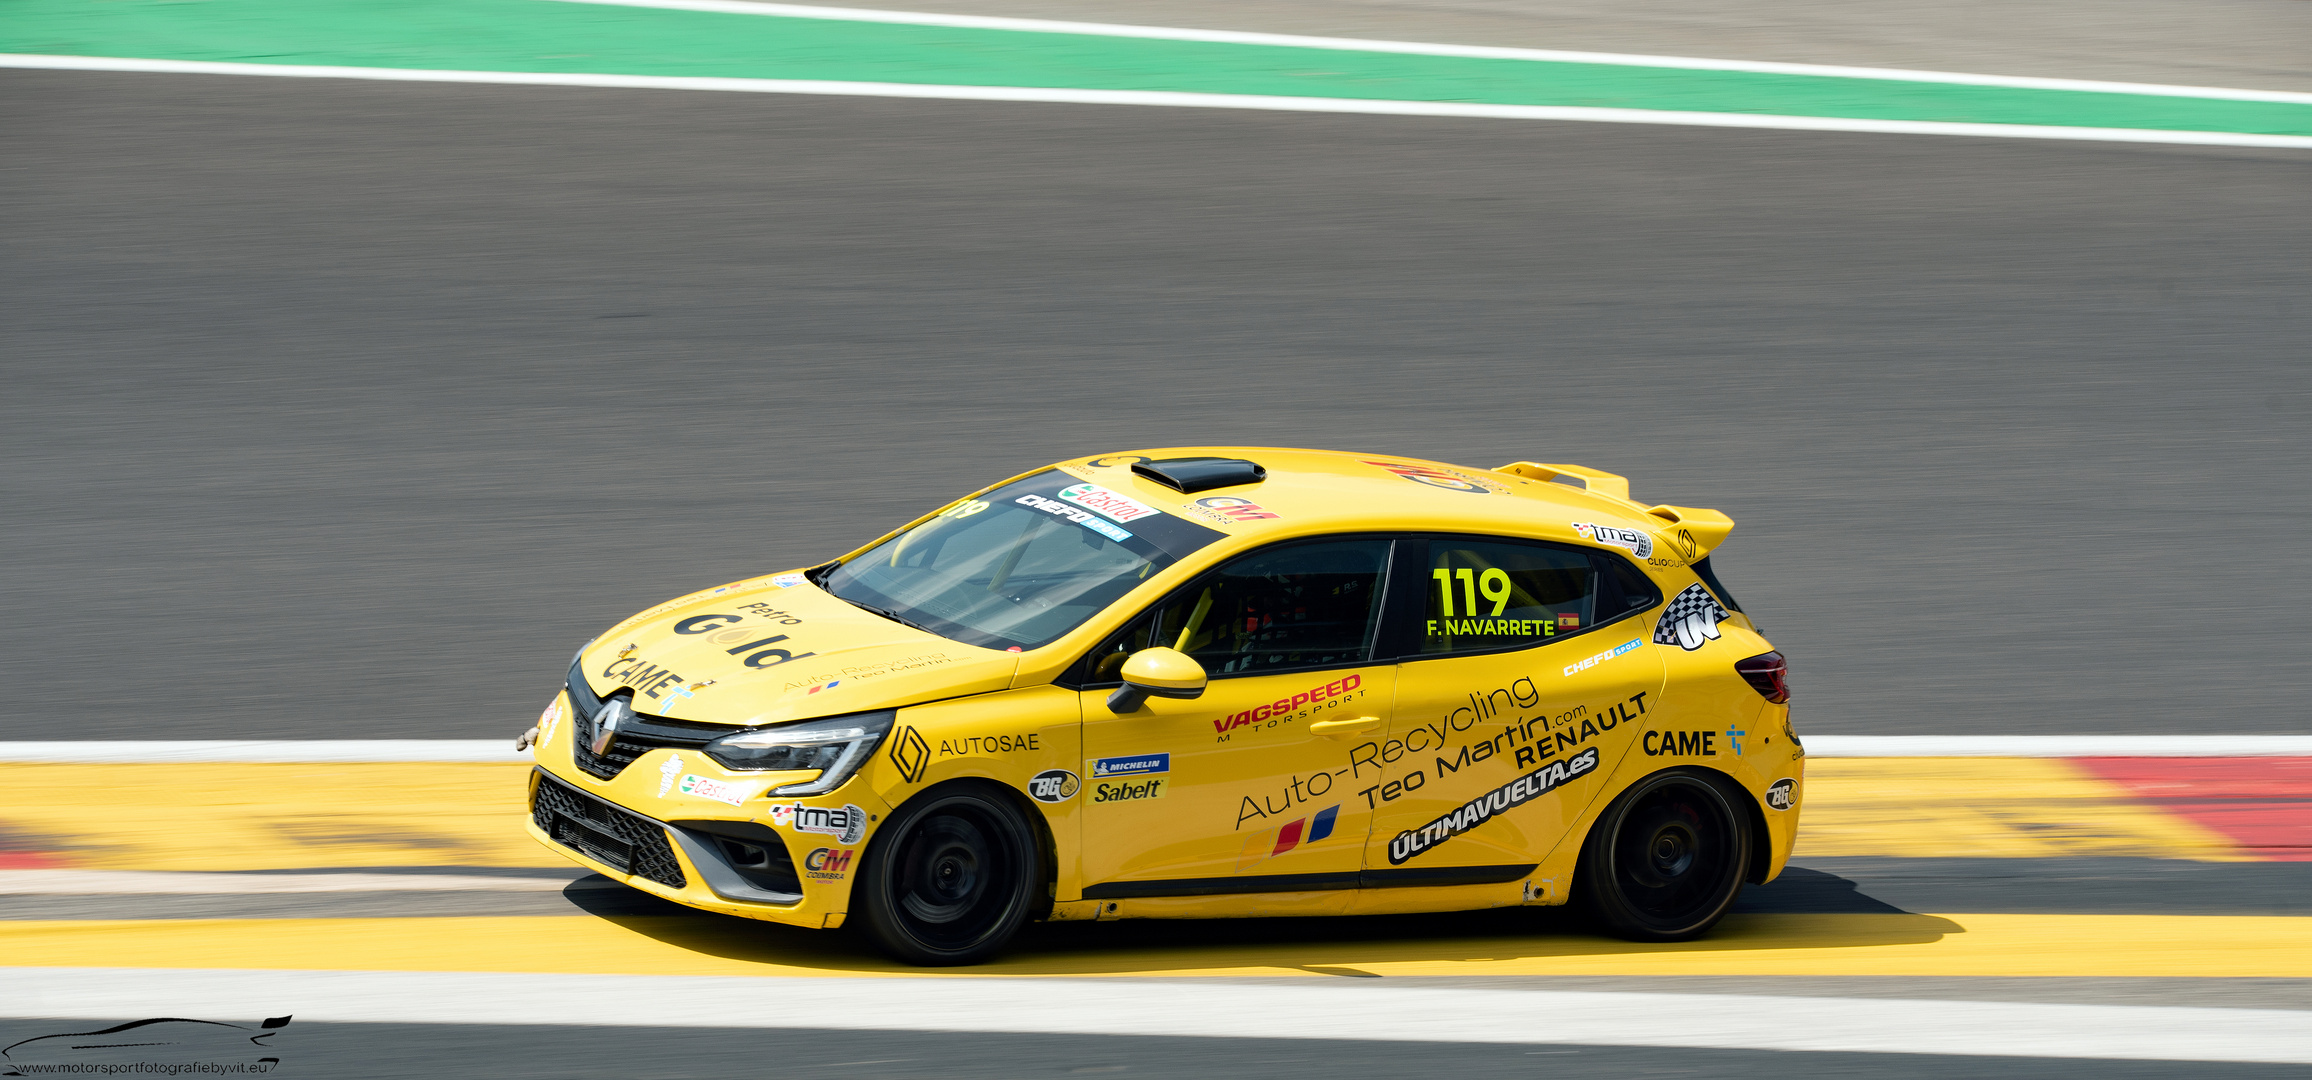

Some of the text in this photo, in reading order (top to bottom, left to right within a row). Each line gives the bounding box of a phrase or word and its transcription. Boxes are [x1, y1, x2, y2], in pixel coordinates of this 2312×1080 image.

[1077, 490, 1150, 521] Castrol
[1086, 519, 1130, 541] SPORT
[1590, 524, 1637, 542] tma
[1433, 567, 1512, 617] 119
[736, 602, 802, 626] Petro
[1427, 619, 1555, 636] F. NAVARRETE
[1615, 639, 1641, 655] SPORT
[603, 657, 684, 700] CAME
[784, 652, 946, 692] Auto-Recycling
[1213, 674, 1361, 733] VAGSPEED
[1514, 691, 1648, 770] RENAULT
[1642, 730, 1716, 756] CAME
[939, 733, 1039, 756] AUTOSAE
[1235, 676, 1539, 830] Auto-Recycling
[1109, 759, 1160, 771] MICHELIN
[1031, 777, 1061, 797] BG
[1094, 780, 1160, 803] Sabelt
[1358, 770, 1425, 810] Teo
[1767, 785, 1790, 806] BG
[794, 803, 847, 830] tma
[1392, 750, 1596, 860] ÚLTIMAVUELTA.es
